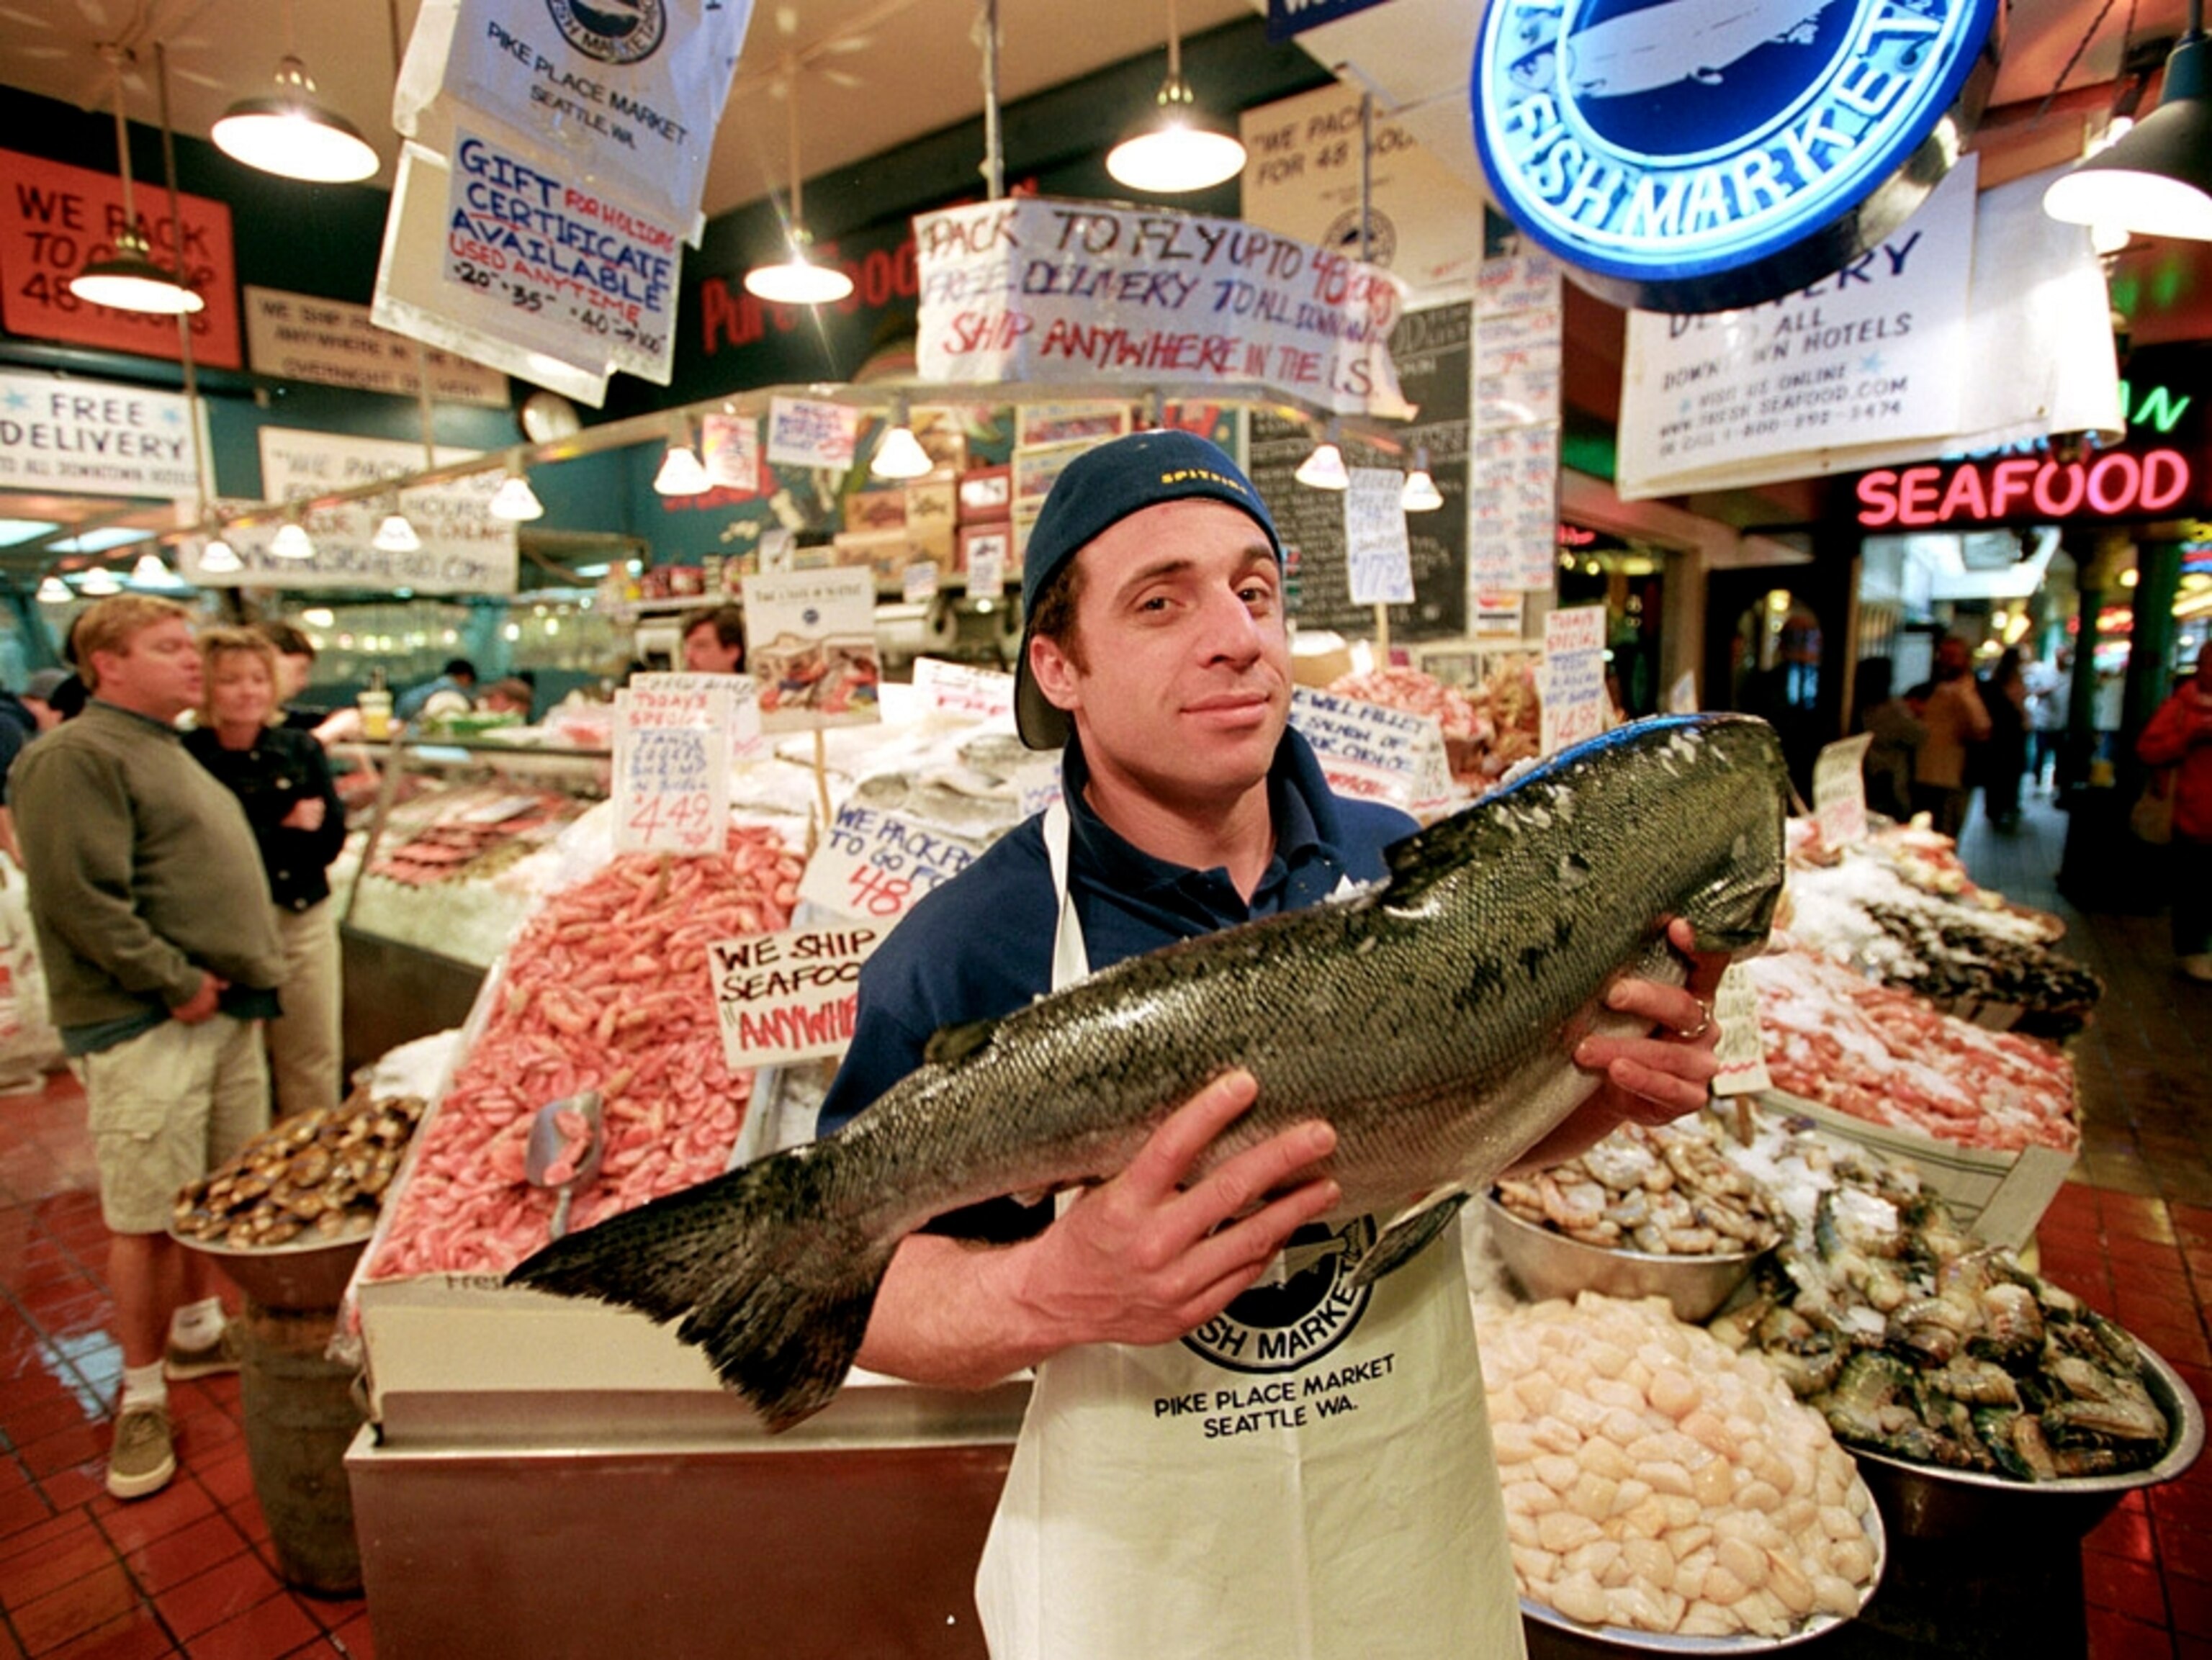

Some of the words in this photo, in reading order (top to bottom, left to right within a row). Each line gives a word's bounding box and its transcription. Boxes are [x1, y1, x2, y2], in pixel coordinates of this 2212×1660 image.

[487, 21, 531, 66] PIKE
[534, 55, 604, 103] PLACE
[609, 91, 688, 145] MARKET
[530, 84, 608, 136] SEATTLE
[1501, 94, 1622, 229] FISH
[1620, 0, 1942, 238] MARKET
[459, 138, 561, 208] GIFT
[16, 182, 85, 232] WE
[105, 203, 211, 261] PACK
[24, 231, 77, 269] TO
[467, 181, 671, 291] CERTIFICATE
[449, 231, 506, 271] USED
[513, 259, 641, 322] ANYTIME
[452, 207, 661, 312] AVAILABLE
[922, 209, 1020, 259] PACK
[1052, 210, 1121, 253] TO
[1132, 217, 1226, 266] FLY
[1310, 248, 1351, 305] 48
[925, 259, 1017, 308] FREE
[1021, 258, 1200, 310] DELIVERY
[20, 271, 81, 312] 48
[942, 310, 1035, 355] SHIP
[1040, 317, 1241, 374] ANYWHERE
[1245, 342, 1271, 379] IN
[1774, 307, 1825, 336] ALL
[1663, 341, 1790, 393] DOWNWN
[1804, 312, 1912, 353] HOTELS
[1778, 363, 1848, 391] ONLINE
[50, 392, 145, 427] FREE
[0, 419, 185, 459] DELIVERY
[1856, 448, 2190, 528] SEAFOOD
[830, 829, 865, 857] TO
[871, 846, 904, 871] GO
[837, 802, 878, 834] WE
[876, 818, 942, 866] PACK
[849, 864, 912, 916] 48
[714, 937, 781, 972] WE
[788, 928, 876, 960] SHIP
[720, 962, 863, 1003] SEAFOO
[446, 1274, 508, 1291] Fres
[1197, 1315, 1248, 1358] SH
[1257, 1253, 1357, 1361] MARKET
[1154, 1393, 1208, 1419] PIKE
[1215, 1382, 1296, 1410] PLACE
[1303, 1353, 1395, 1397] MARKET
[1203, 1406, 1307, 1439] SEATTLE
[1315, 1394, 1359, 1420] WA.
